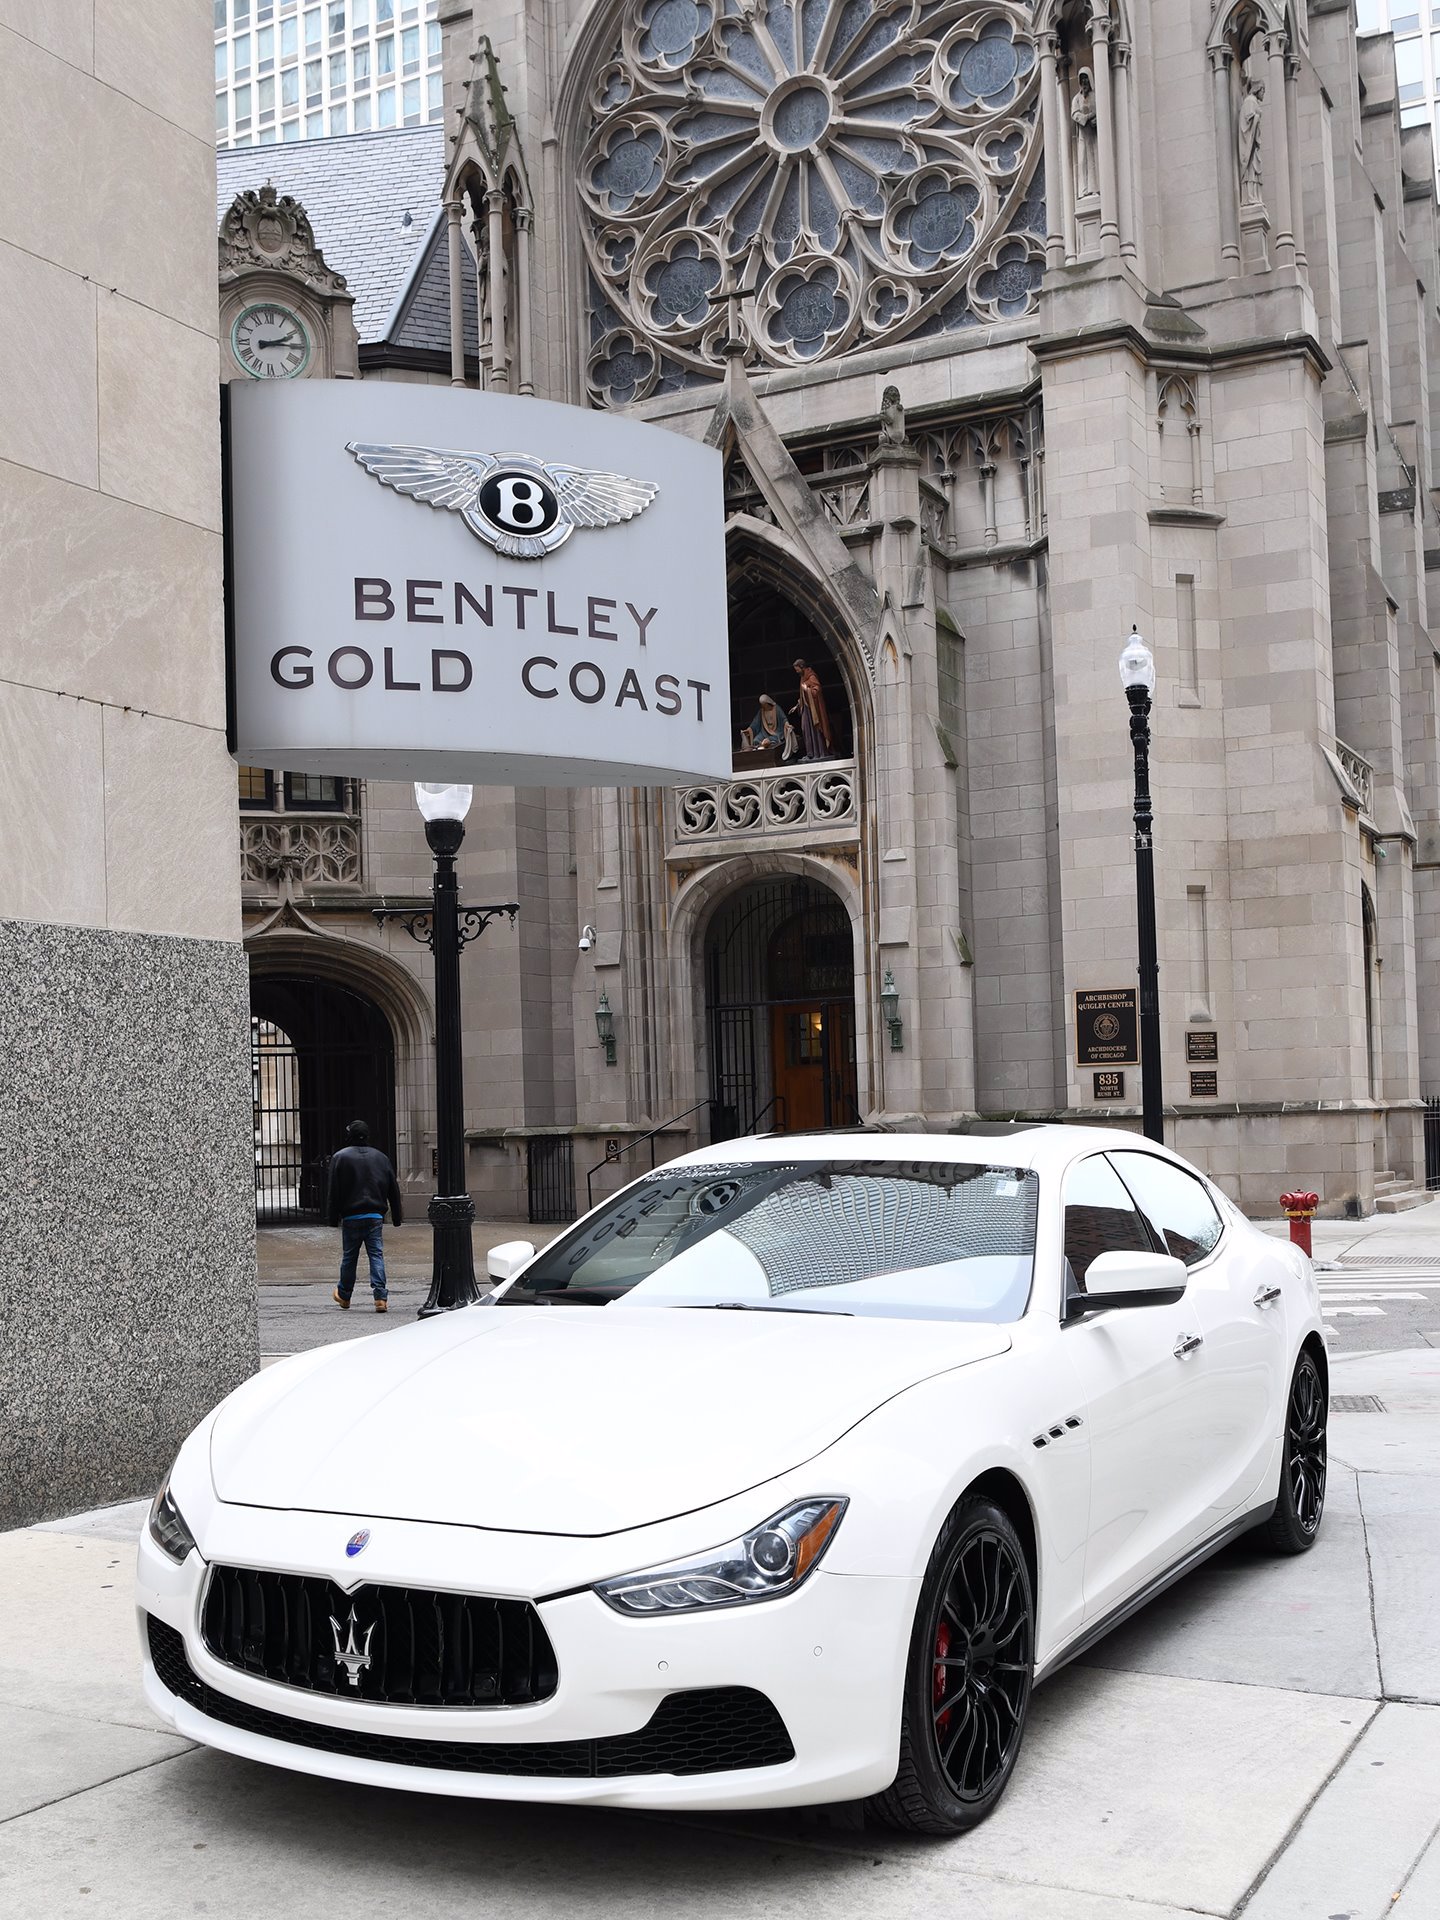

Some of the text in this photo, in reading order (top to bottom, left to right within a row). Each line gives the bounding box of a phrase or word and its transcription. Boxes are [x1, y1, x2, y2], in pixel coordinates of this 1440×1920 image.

[496, 477, 546, 528] B
[353, 577, 659, 647] BENTLEY
[270, 644, 711, 722] GOLD COAST
[1085, 993, 1127, 1001] ARCHBISHOP
[1107, 1001, 1134, 1009] CENTER
[1099, 1073, 1119, 1085] 835
